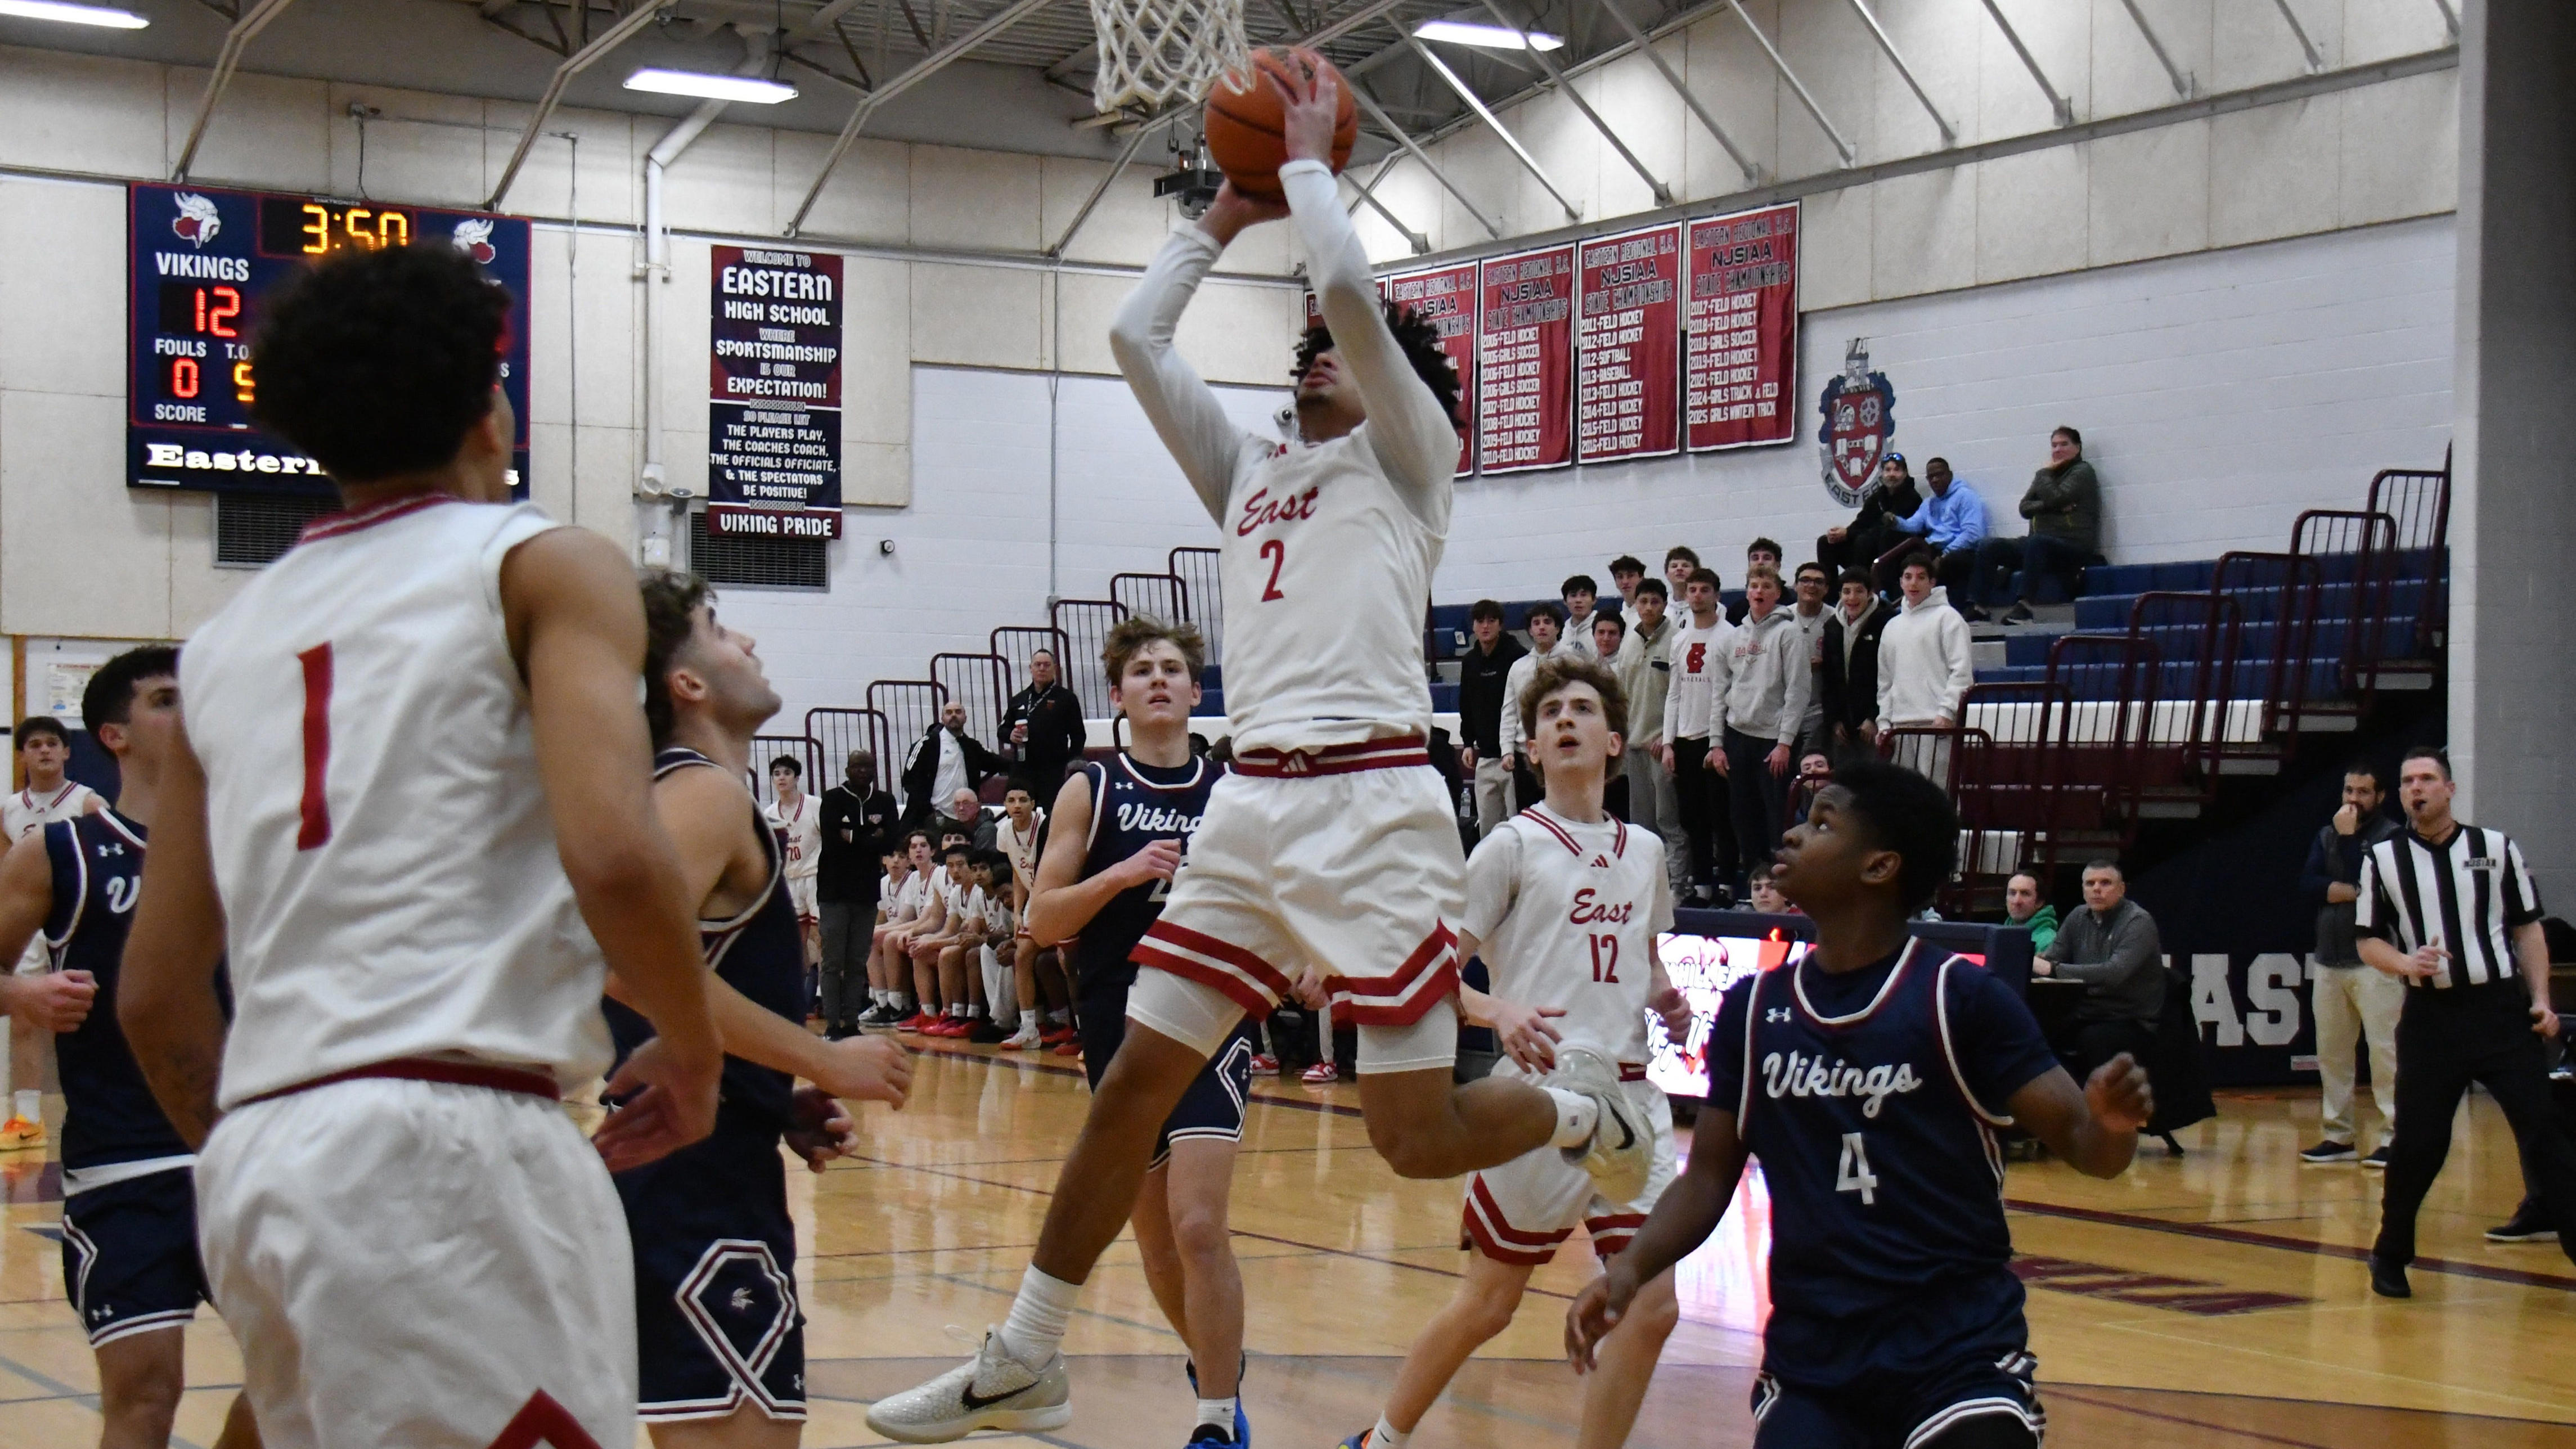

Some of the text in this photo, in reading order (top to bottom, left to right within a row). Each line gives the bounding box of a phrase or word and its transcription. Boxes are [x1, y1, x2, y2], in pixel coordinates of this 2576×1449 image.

[1694, 226, 1729, 249] EASTERN
[1734, 217, 1771, 242] REGIONAL
[743, 250, 811, 267] WELCOME TO
[1585, 245, 1618, 269] EASTERN
[1621, 237, 1657, 262] REGIONAL
[1712, 242, 1773, 268] NJSIAA
[155, 252, 249, 281] VIKINGS
[1486, 264, 1517, 286] EASTERN
[1519, 257, 1553, 280] REGIONAL
[1601, 259, 1657, 288] NJSIAA
[723, 267, 831, 301] EASTERN
[1395, 281, 1424, 302] EASTERN
[1426, 275, 1456, 297] REGIONAL
[1696, 262, 1790, 297] STATE CHAMPIONSHIPS
[1501, 279, 1553, 305] NJSIAA
[1585, 278, 1672, 315] STATE CHAMPIONSHIPS
[1731, 292, 1757, 307] HOCKEY
[195, 287, 240, 337] 12
[725, 301, 830, 326] HIGH SCHOOL
[1487, 298, 1567, 331] STATE CHAMPIONSHIPS
[1619, 309, 1644, 327] HOCKEY
[1731, 310, 1757, 328] HOCKEY
[759, 328, 795, 343] WHERE
[1517, 326, 1539, 343] HOCKEY
[1619, 327, 1643, 344] HOCKEY
[1731, 330, 1757, 346] SOCCER
[155, 338, 207, 358] FOULS
[716, 340, 837, 363] SPORTSMANSHIP
[1517, 344, 1539, 359] SOCCER
[1731, 348, 1757, 365] HOCKEY
[760, 362, 795, 377] IS OUR
[1517, 361, 1540, 376] HOCKEY
[1730, 366, 1758, 382] HOCKEY
[173, 359, 198, 398] 0
[727, 376, 826, 398] EXPECTATION!
[1517, 378, 1539, 393] SOCCER
[1619, 380, 1643, 397] HOCKEY
[1730, 385, 1752, 400] TRACK
[1763, 382, 1778, 398] FIELD
[1516, 395, 1540, 410] HOCKEY
[1619, 398, 1643, 415] HOCKEY
[1710, 406, 1728, 422] GIRLS
[1730, 403, 1755, 420] WINTER
[1757, 400, 1775, 416] TRACK
[155, 404, 206, 422] SCORE
[744, 411, 810, 425] SO PLEASE LET
[1515, 412, 1540, 428] HOCKEY
[1619, 416, 1643, 431] HOCKEY
[727, 424, 826, 442] THE PLAYERS PLAY,
[1515, 429, 1540, 444] HOCKEY
[1619, 433, 1643, 449] HOCKEY
[723, 439, 829, 457] THE COACHES COACH,
[1515, 446, 1540, 461] HOCKEY
[711, 453, 837, 472] THE OFFICIALS OFFICIATE,
[726, 469, 823, 485] & THE SPECTATORS
[743, 485, 807, 498] BE POSITIVE!
[1237, 486, 1319, 537] East
[720, 514, 833, 536] VIKING PRIDE
[1260, 539, 1284, 602] 2
[297, 640, 334, 851] 1
[1570, 888, 1632, 925] East
[1589, 933, 1619, 983] 12
[1763, 1050, 1923, 1118] Vikings
[1836, 1132, 1877, 1204] 4
